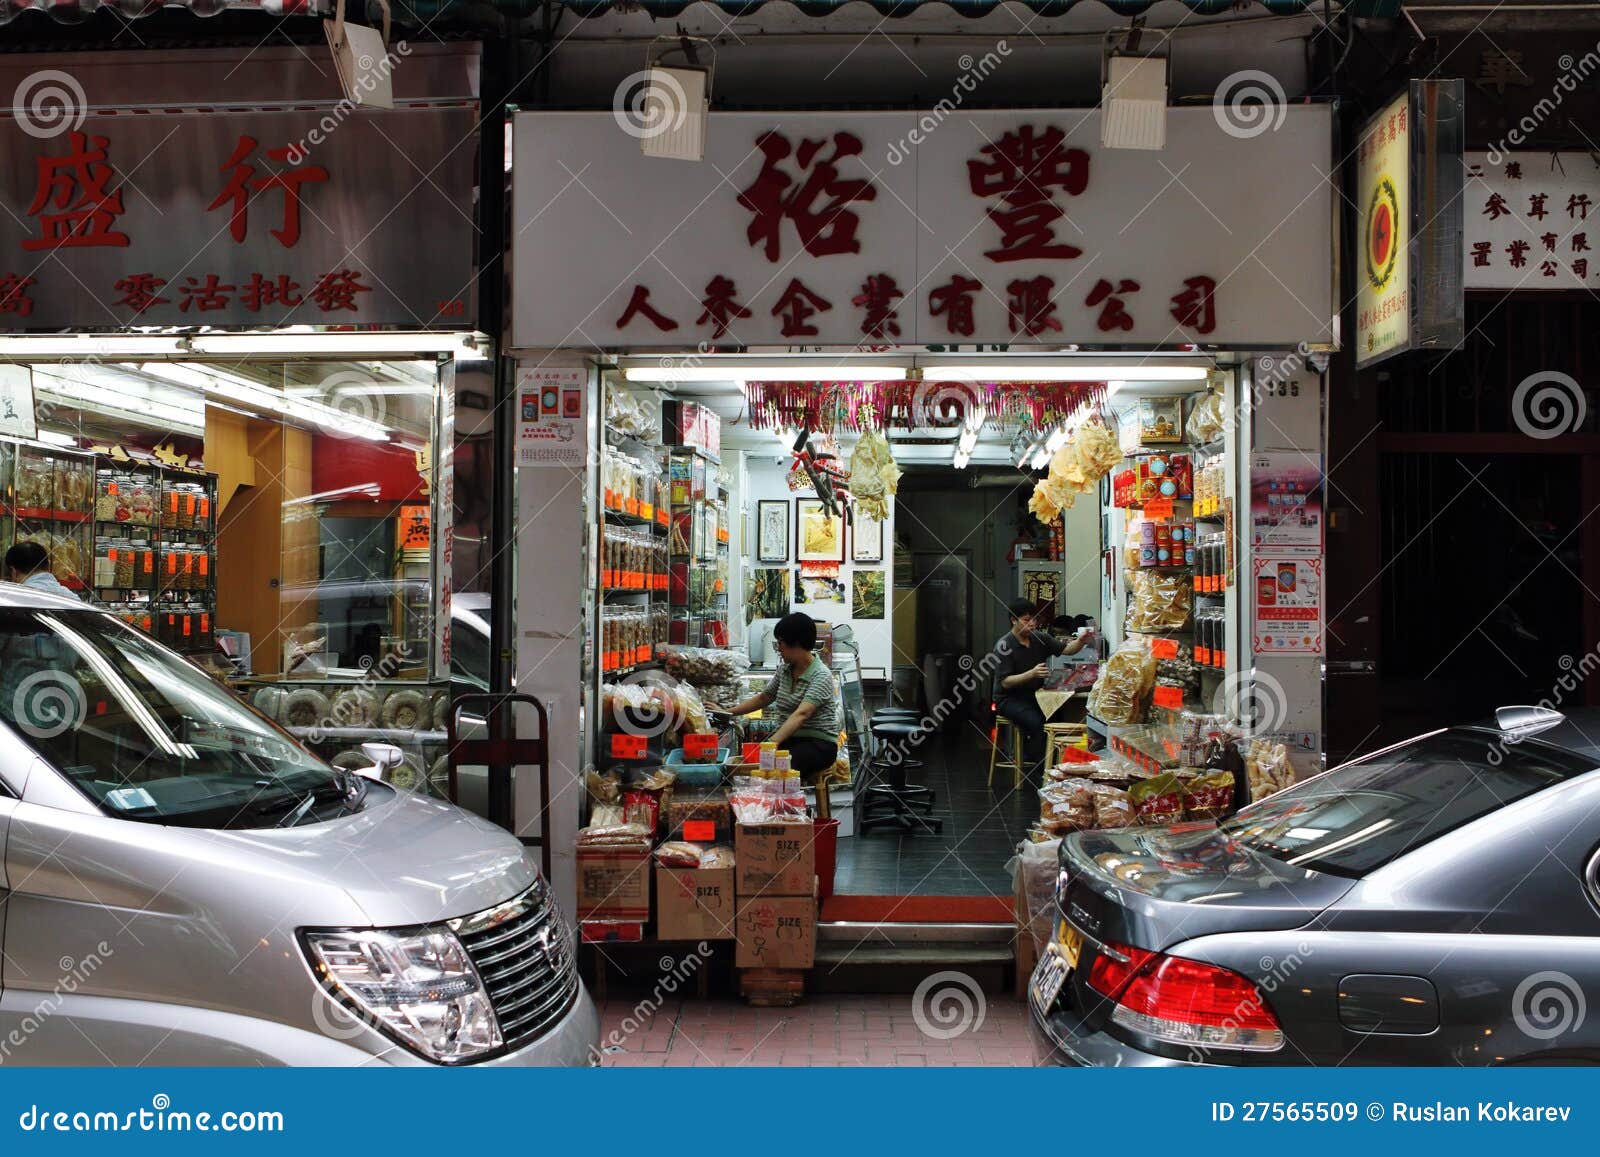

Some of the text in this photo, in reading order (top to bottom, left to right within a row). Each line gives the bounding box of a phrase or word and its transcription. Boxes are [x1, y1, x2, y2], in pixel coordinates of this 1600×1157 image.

[776, 840, 801, 850] SIZE
[696, 886, 720, 897] SIZE
[777, 917, 801, 928] SIZE
